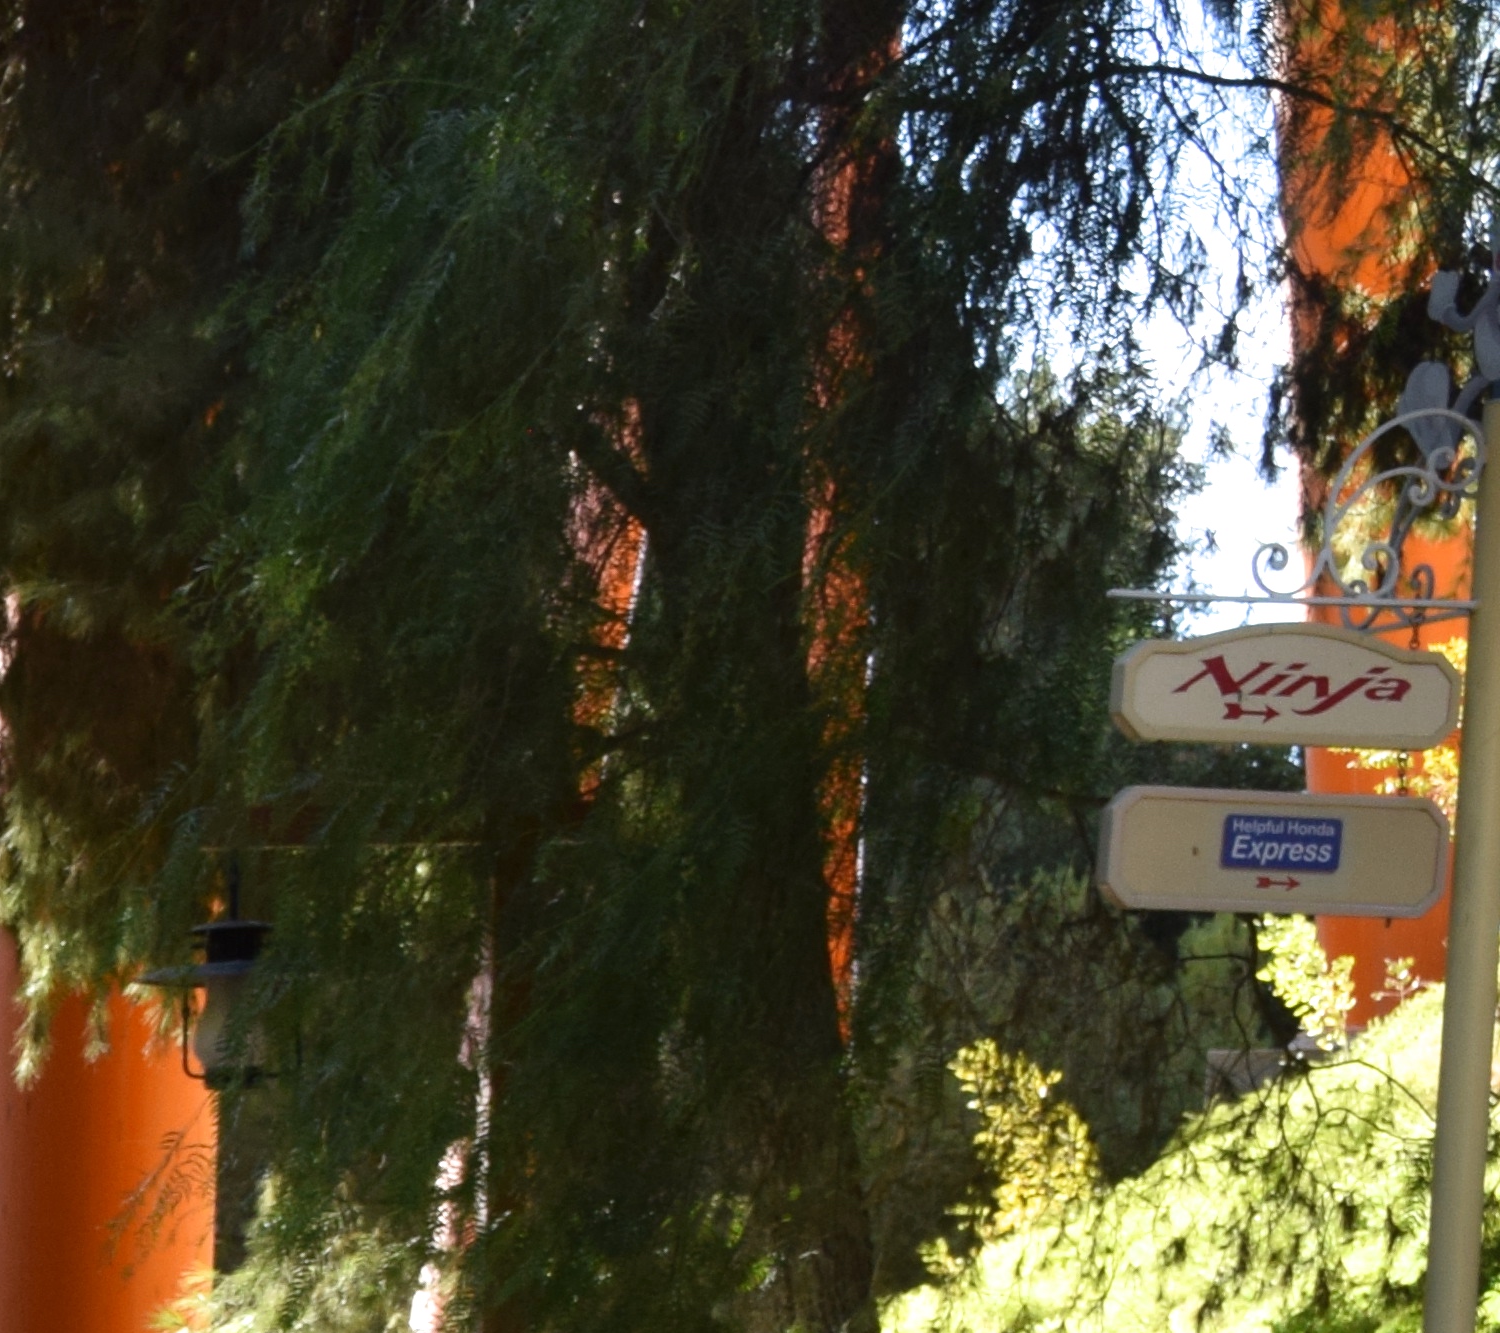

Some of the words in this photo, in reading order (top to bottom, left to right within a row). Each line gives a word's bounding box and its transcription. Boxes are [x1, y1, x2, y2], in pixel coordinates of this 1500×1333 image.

[1171, 654, 1412, 716] Ninja
[1232, 819, 1284, 836] Helpful
[1287, 820, 1335, 837] Honda
[1230, 834, 1333, 866] Express
